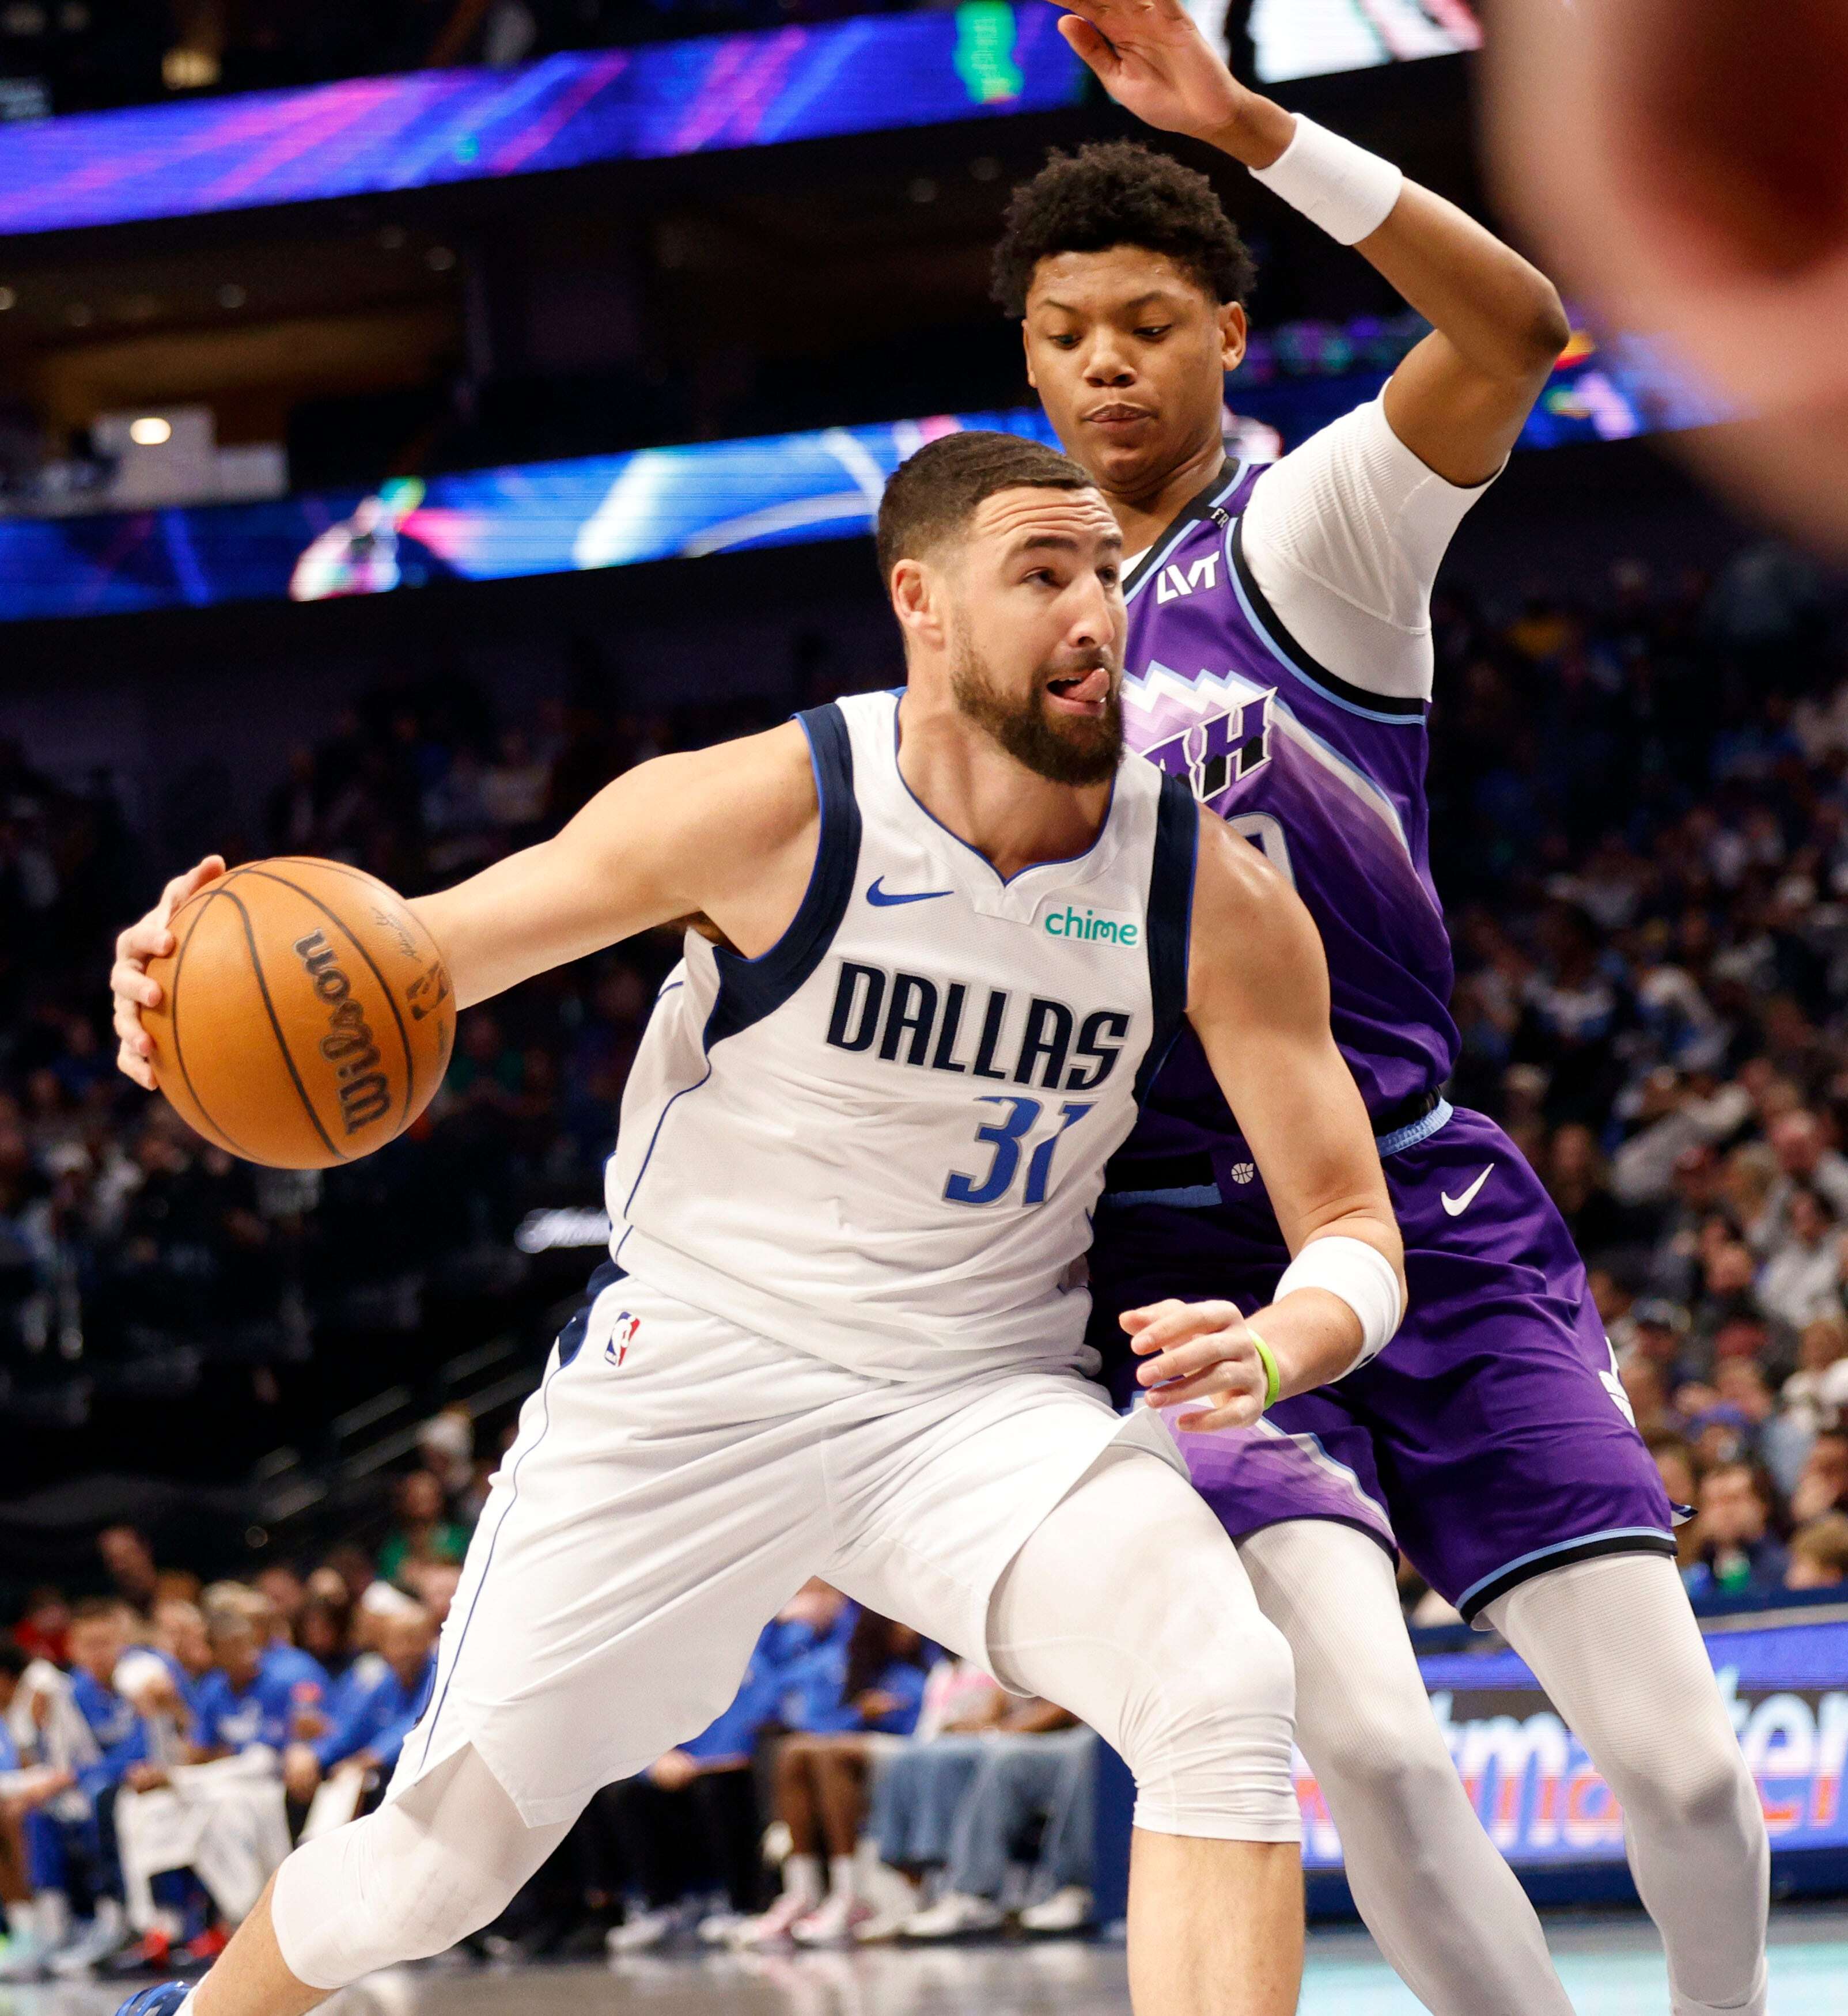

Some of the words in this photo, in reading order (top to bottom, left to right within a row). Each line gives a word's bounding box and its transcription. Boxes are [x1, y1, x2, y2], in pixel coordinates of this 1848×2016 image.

[1045, 907, 1139, 947] chime
[292, 927, 393, 1136] Wilson
[825, 957, 1134, 1092] DALLAS
[942, 1096, 1099, 1208] 31
